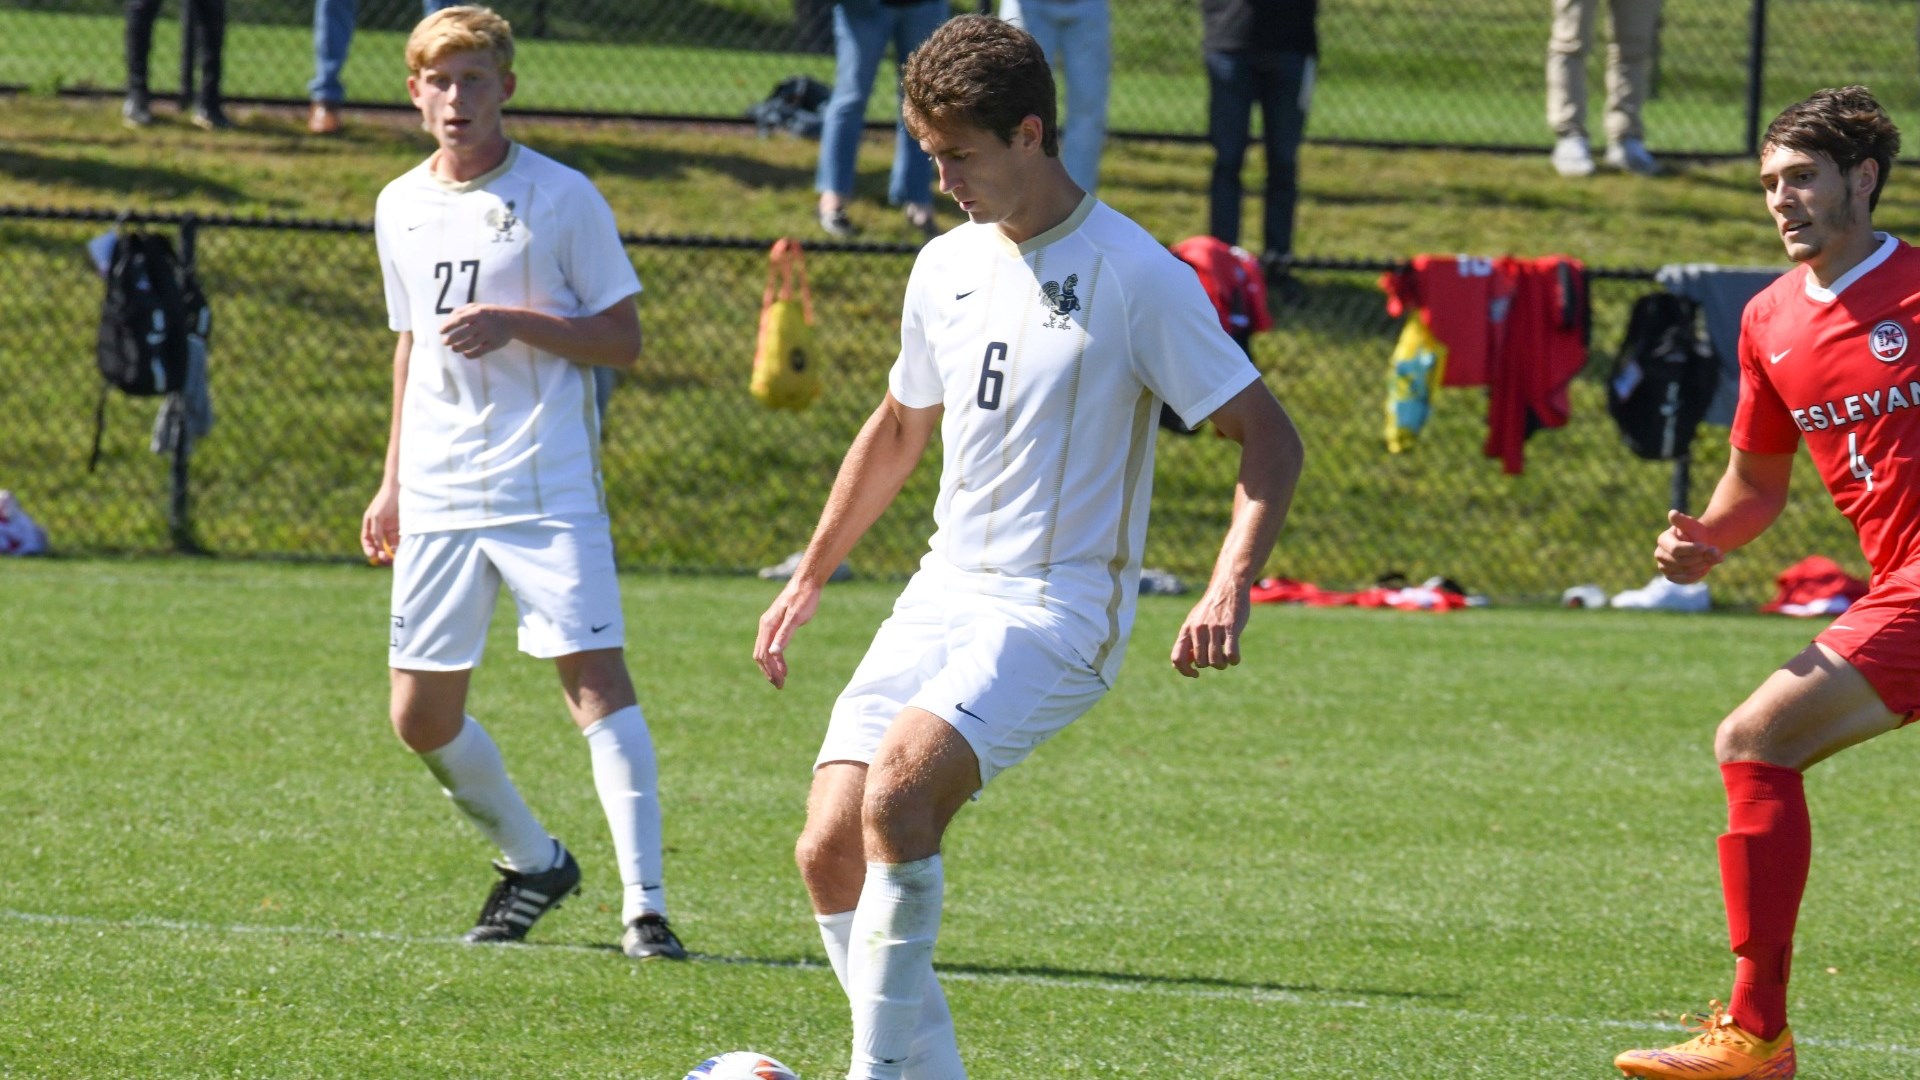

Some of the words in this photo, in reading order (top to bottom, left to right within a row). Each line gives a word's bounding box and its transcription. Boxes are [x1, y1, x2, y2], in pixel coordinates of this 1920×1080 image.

[434, 259, 481, 315] 27
[977, 341, 1008, 411] 6
[1790, 381, 1920, 433] ESLEYAN
[1848, 432, 1874, 492] 4
